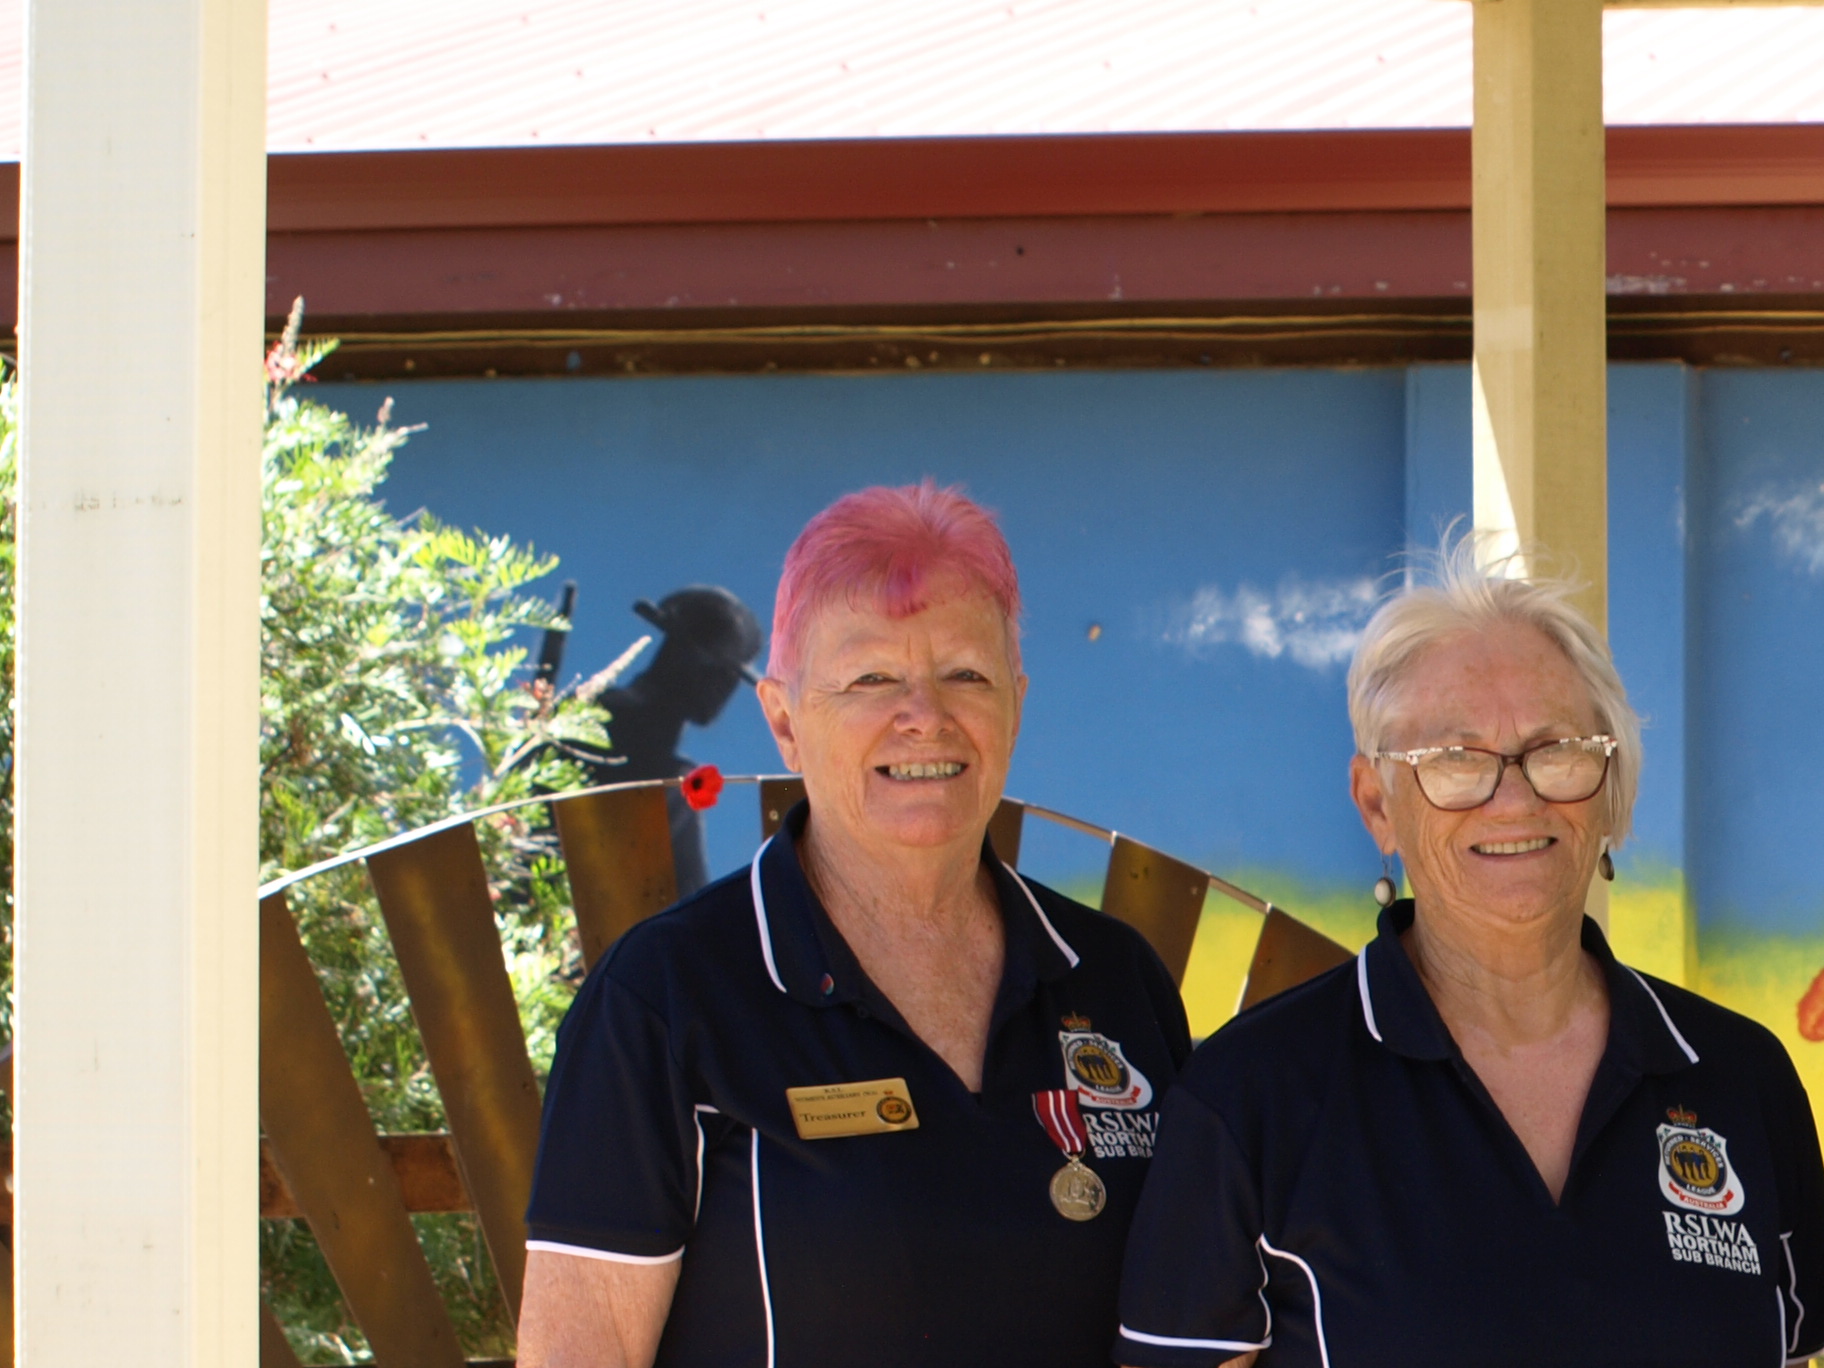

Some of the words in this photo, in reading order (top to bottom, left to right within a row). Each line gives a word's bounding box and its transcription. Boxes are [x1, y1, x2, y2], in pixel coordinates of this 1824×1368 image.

[799, 1110, 866, 1123] Treasurer
[1093, 1144, 1125, 1158] SUB
[1690, 1136, 1724, 1168] SERVICES
[1685, 1183, 1715, 1195] LEAGUE
[1683, 1196, 1725, 1210] AUSTRALIA
[1662, 1211, 1757, 1247] RSLWA
[1668, 1233, 1759, 1262] NORTHAM
[1671, 1247, 1703, 1264] SUB
[1705, 1252, 1762, 1275] BRANCH
